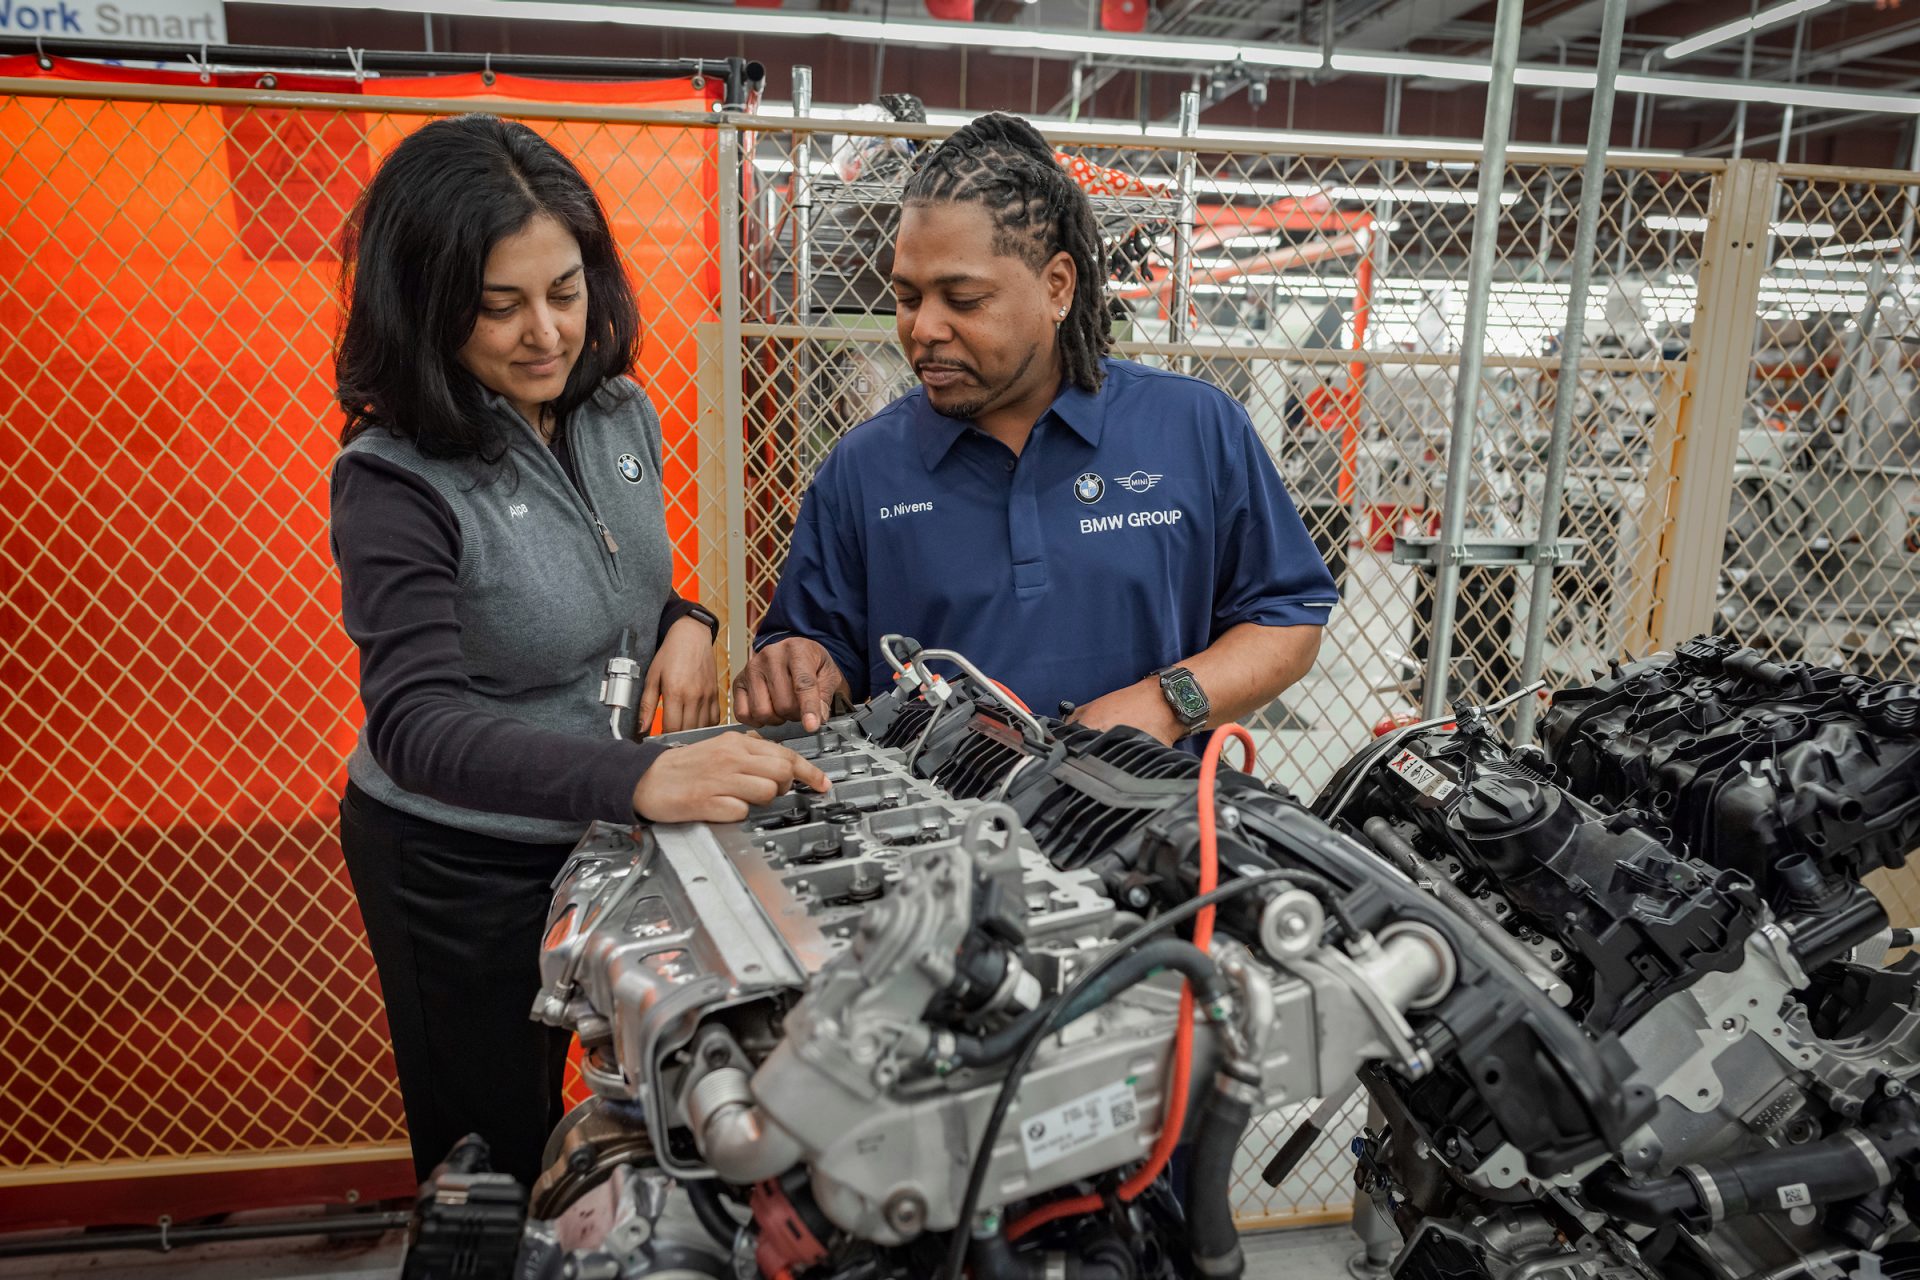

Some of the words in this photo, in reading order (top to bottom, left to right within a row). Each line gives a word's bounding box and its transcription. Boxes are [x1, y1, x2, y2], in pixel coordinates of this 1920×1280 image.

[96, 4, 219, 41] Smart
[1131, 478, 1149, 487] MINI
[1080, 514, 1124, 534] BMW
[1127, 509, 1182, 527] GROUP
